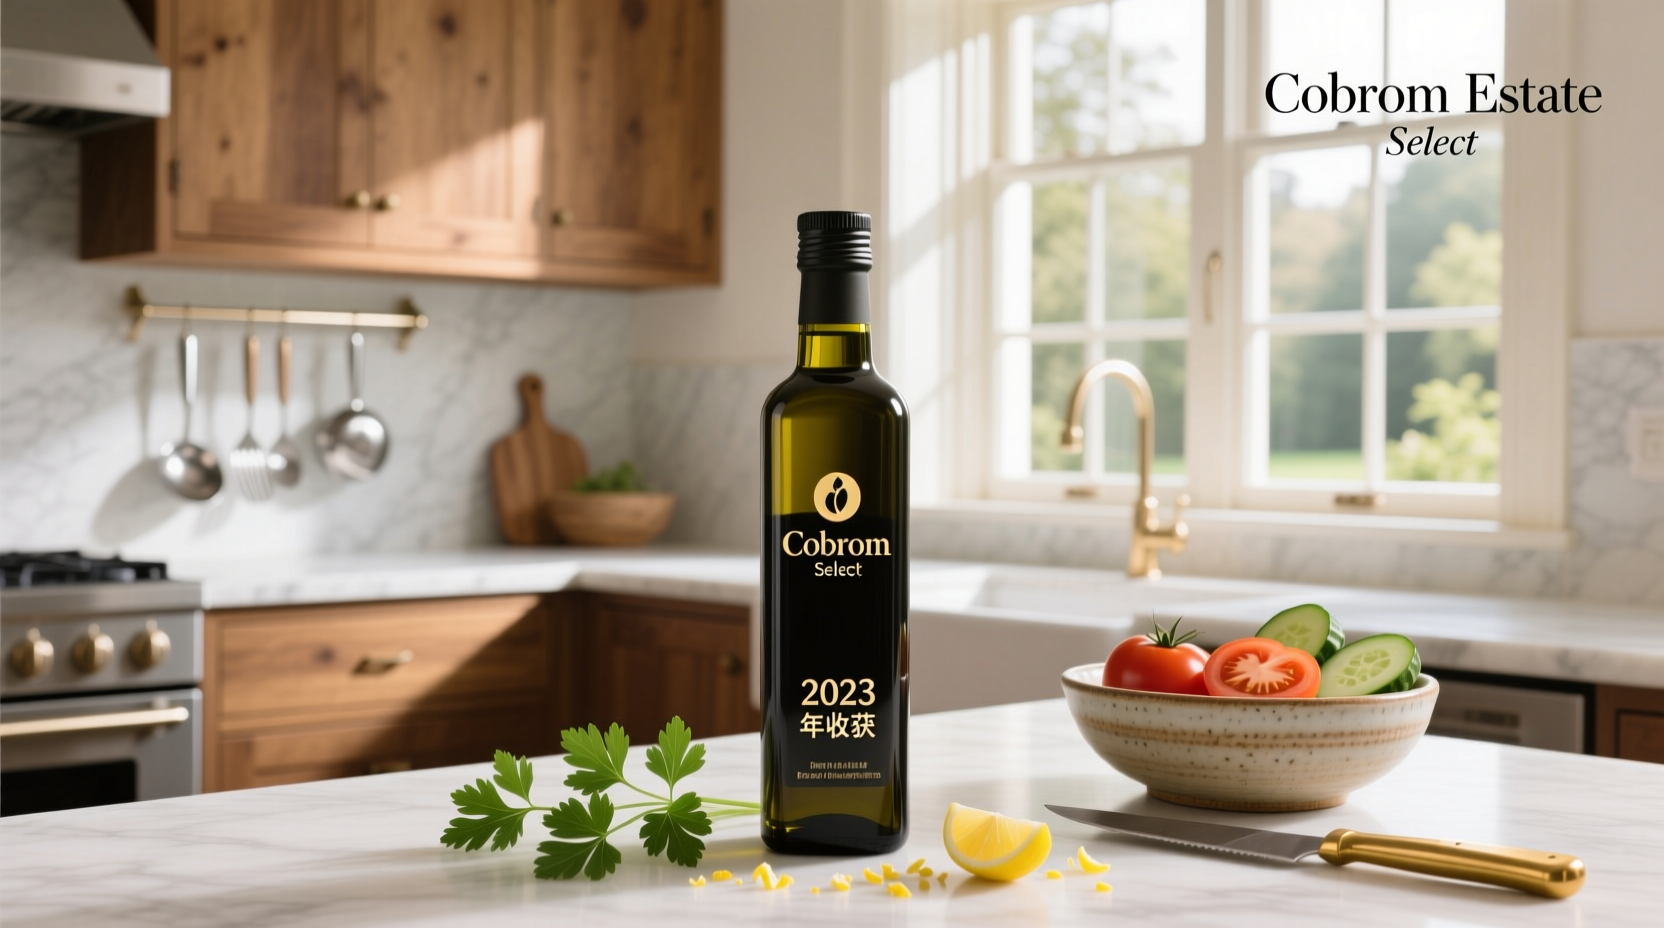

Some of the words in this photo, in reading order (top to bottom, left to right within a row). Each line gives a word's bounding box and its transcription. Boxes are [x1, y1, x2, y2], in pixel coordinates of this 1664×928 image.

[782, 529, 892, 557] Cobrom
[814, 560, 863, 578] Select
[801, 678, 876, 706] 2023
[799, 711, 876, 739] 年收获
